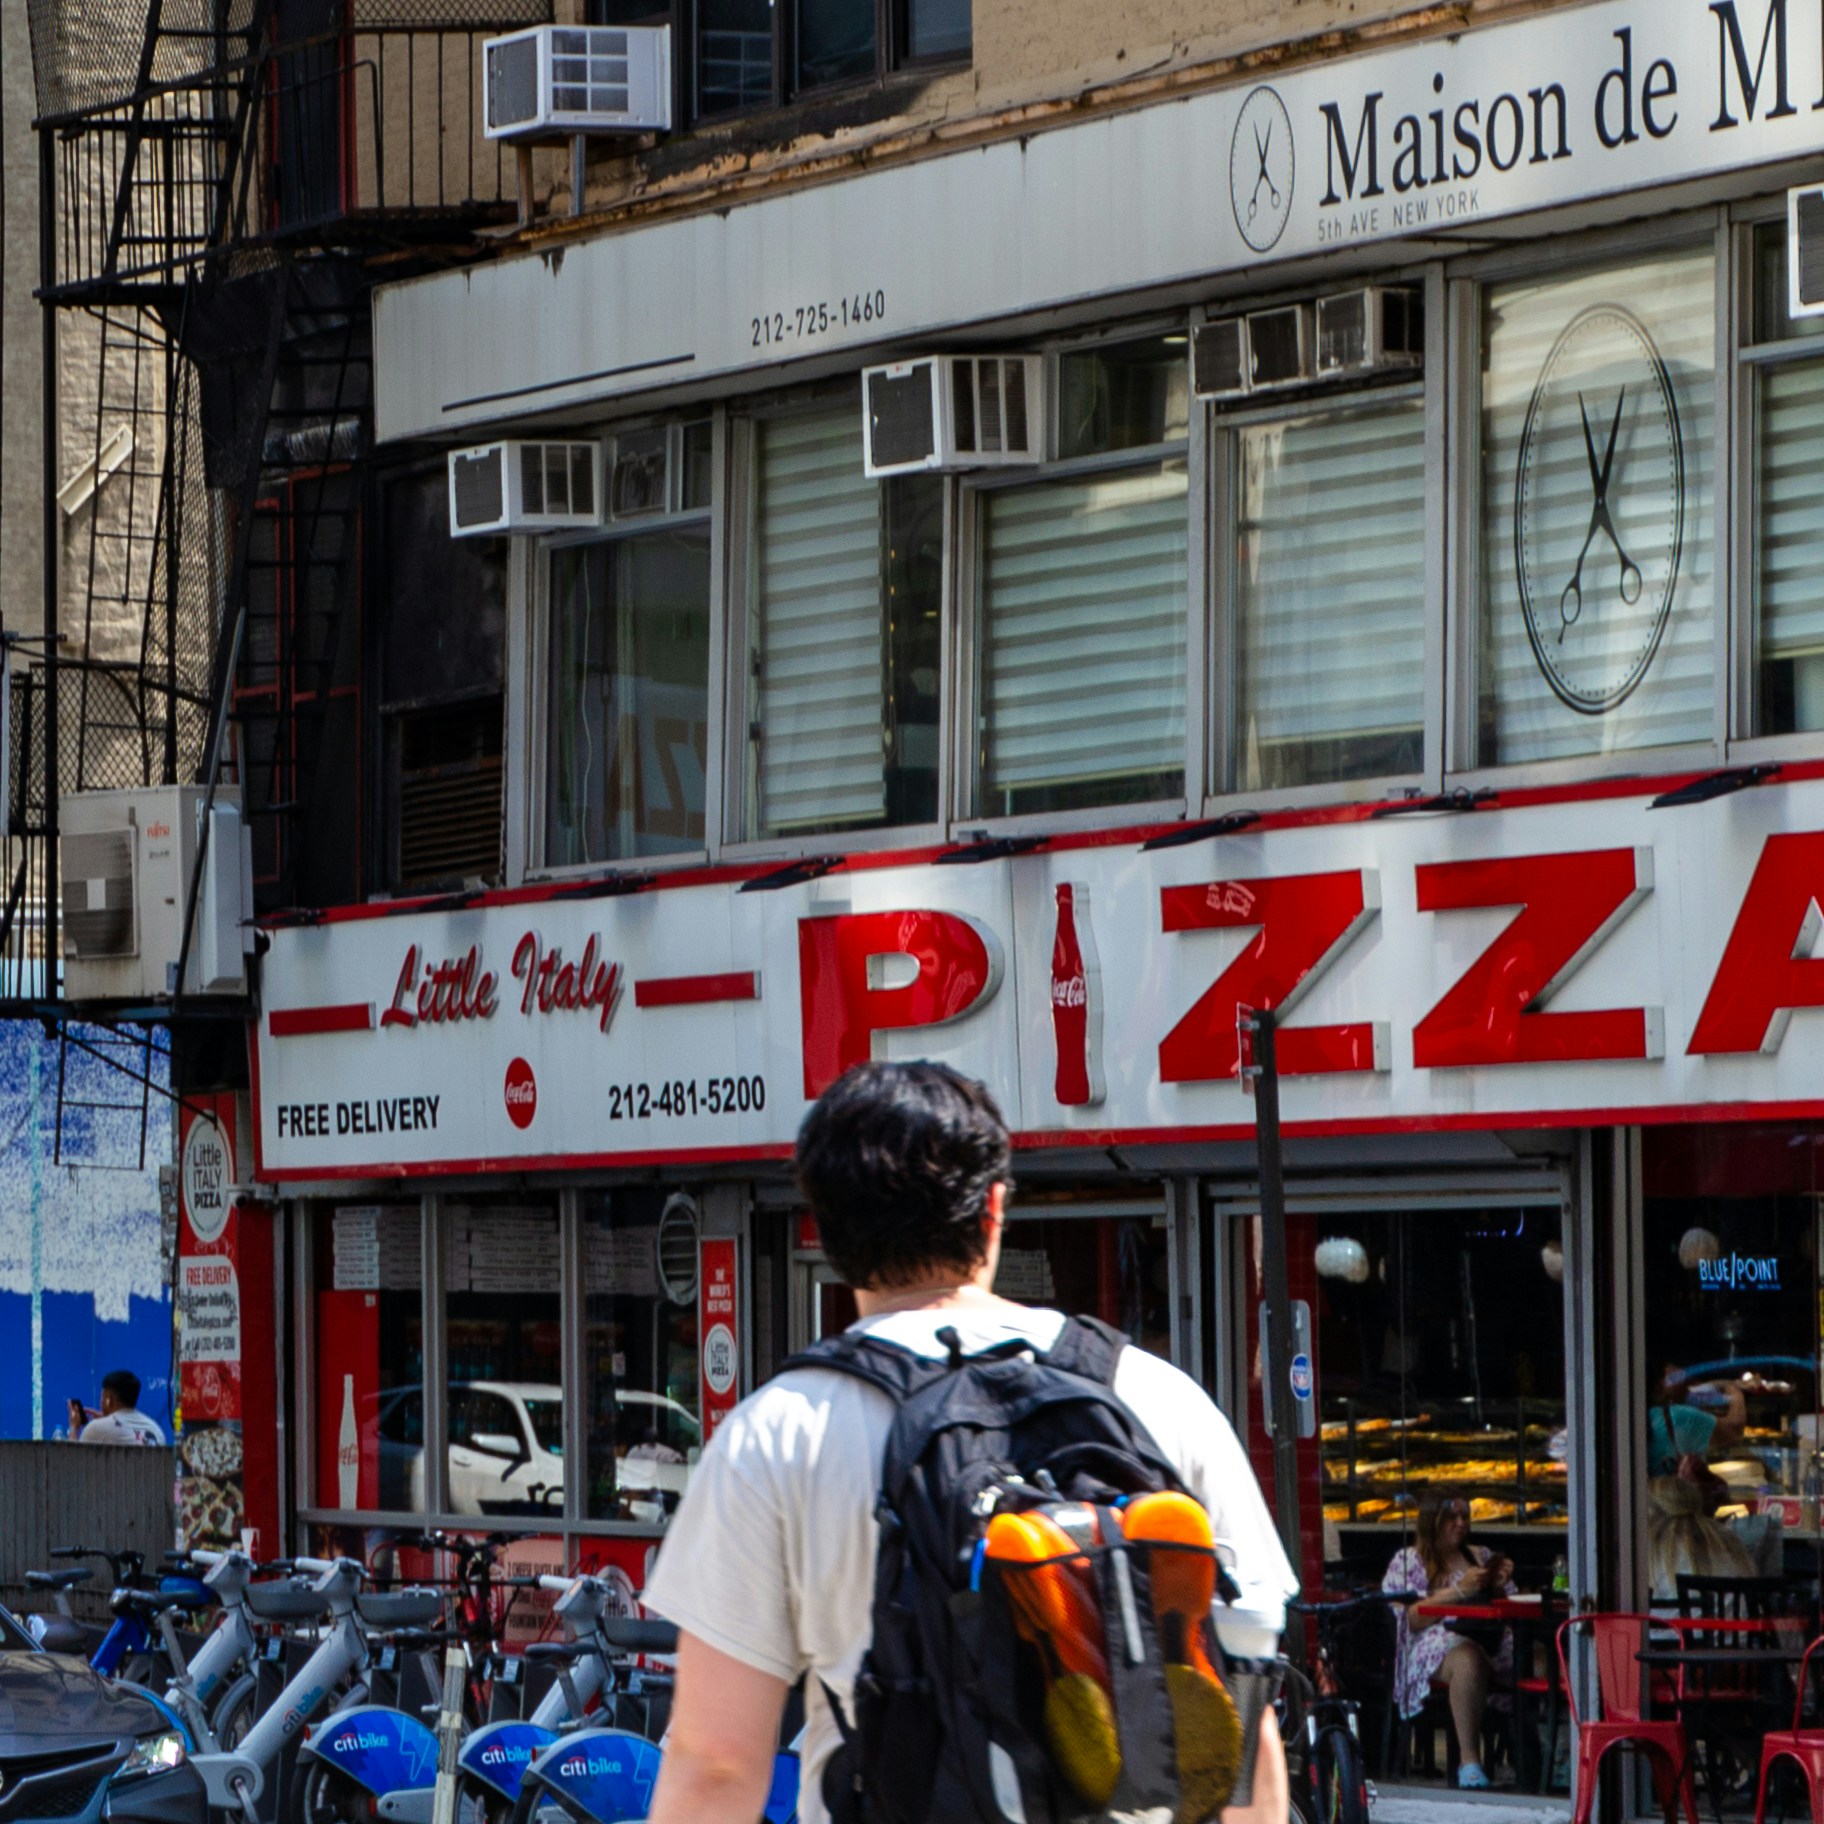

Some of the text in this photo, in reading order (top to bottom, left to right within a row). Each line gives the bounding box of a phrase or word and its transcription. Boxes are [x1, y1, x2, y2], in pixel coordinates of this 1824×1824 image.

[1318, 71, 1573, 208] Maison
[1593, 26, 1679, 150] de
[1317, 189, 1481, 243] 5th AVE NEW YORK
[751, 289, 887, 347] 212-725-1460
[381, 929, 626, 1034] Little Italy
[277, 1094, 441, 1139] FREE DELIVERY
[608, 1075, 767, 1122] 212-481-5200
[193, 1143, 222, 1167] Little
[193, 1167, 222, 1190] ITALY
[194, 1190, 222, 1209] PIZZA
[186, 1265, 231, 1286] FREE DELIVERY
[711, 1365, 729, 1376] PIZZA
